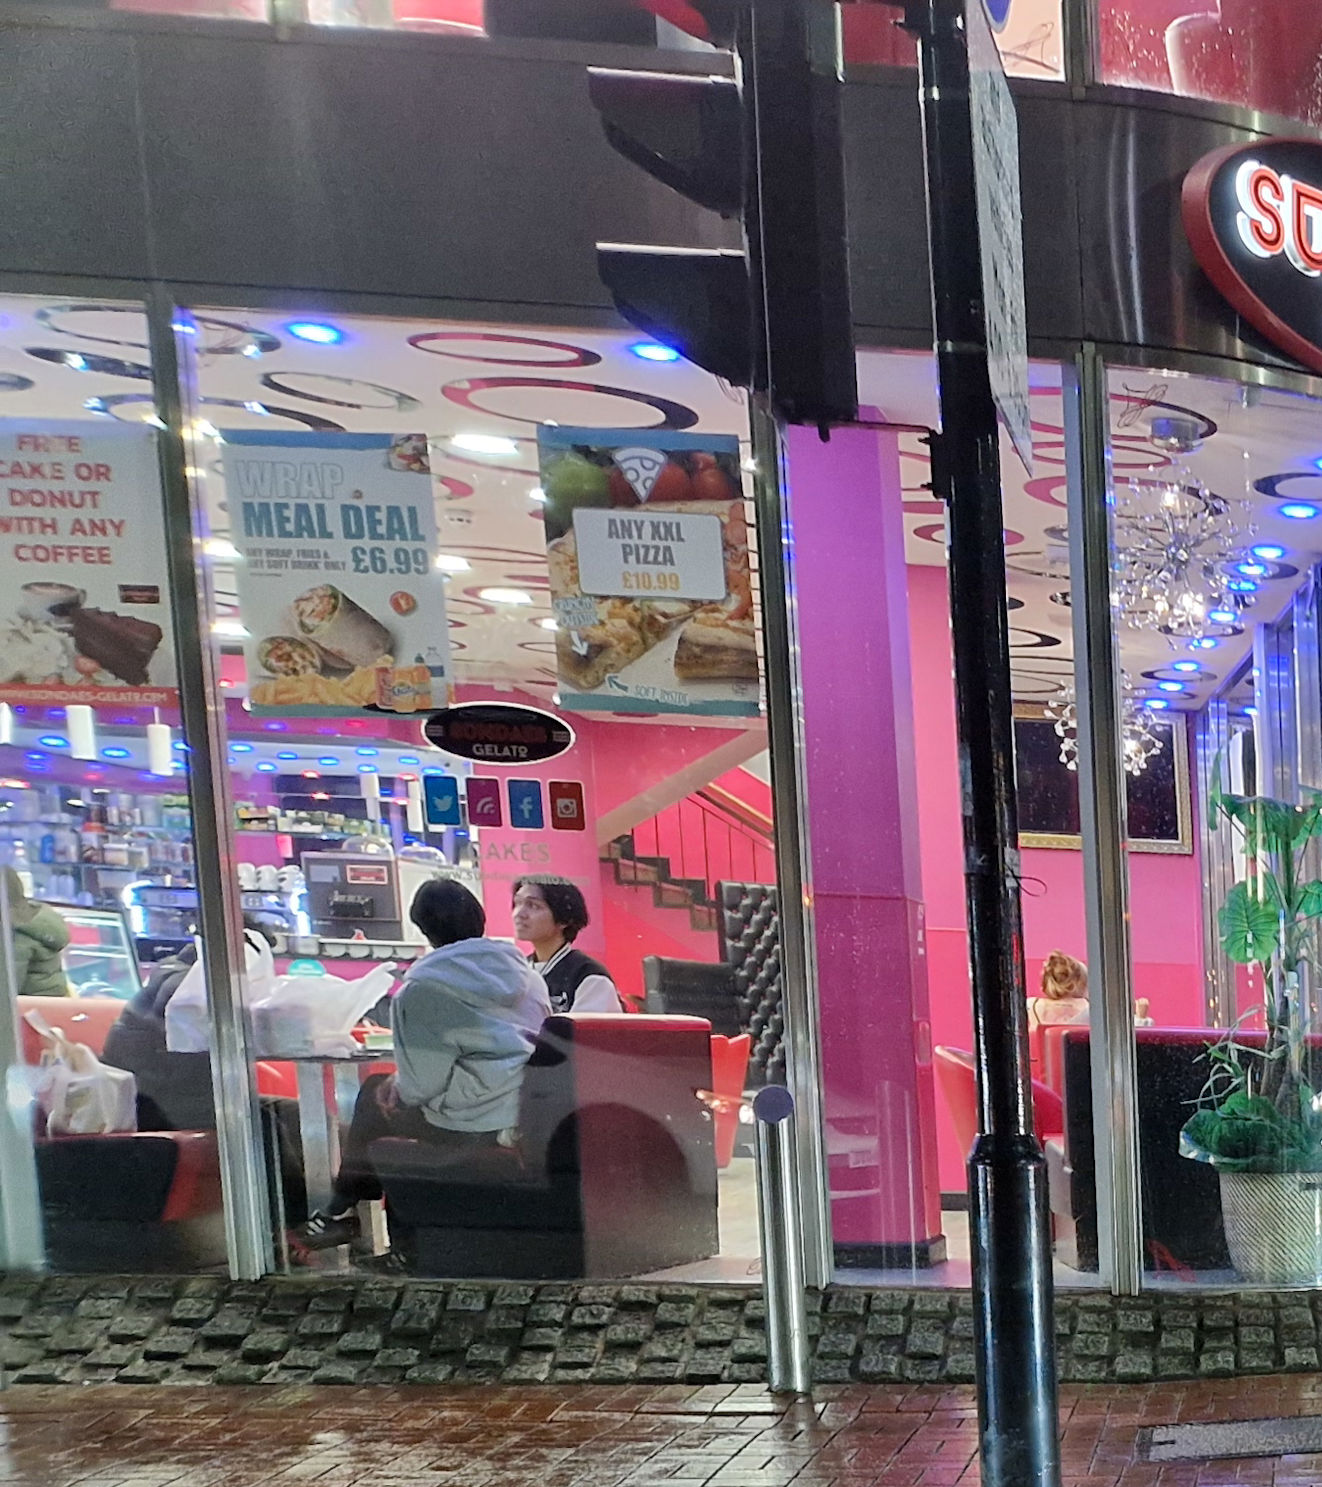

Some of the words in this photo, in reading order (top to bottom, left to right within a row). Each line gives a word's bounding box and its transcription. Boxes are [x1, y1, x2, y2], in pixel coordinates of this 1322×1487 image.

[74, 462, 112, 482] OR
[234, 459, 345, 500] WRAP
[8, 488, 101, 509] DONUT
[69, 518, 126, 537] ANY
[242, 501, 334, 540] MEAL
[340, 503, 426, 542] DEAL
[607, 518, 646, 541] ANY
[649, 521, 685, 542] XXL
[14, 543, 112, 565] COFFEE
[351, 545, 430, 575] £6.99
[621, 545, 676, 567] PIZZA
[621, 571, 681, 592] £10.99
[472, 743, 529, 759] GELATO
